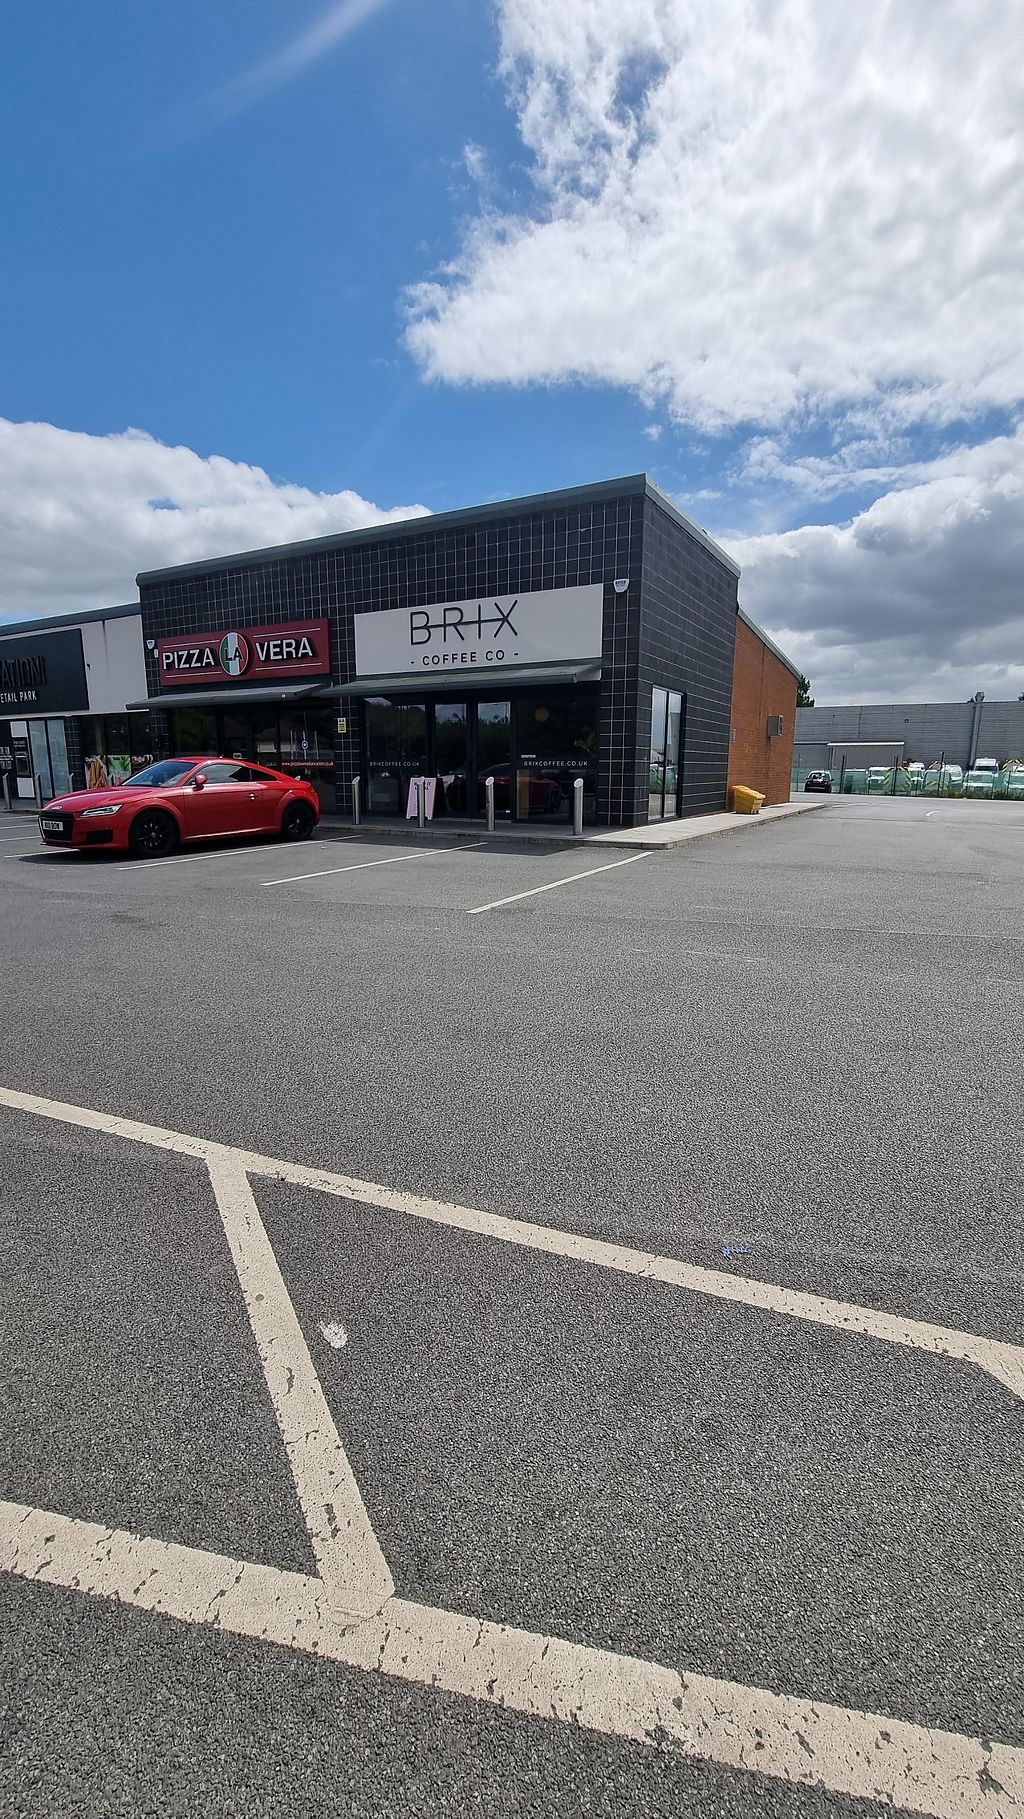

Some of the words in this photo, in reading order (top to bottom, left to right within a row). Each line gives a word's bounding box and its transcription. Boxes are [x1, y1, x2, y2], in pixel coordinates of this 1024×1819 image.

[410, 600, 518, 646] BRIX
[162, 647, 215, 670] PIZZA
[224, 645, 244, 663] LA
[255, 637, 313, 661] VERA
[422, 651, 477, 666] COFFEE
[485, 649, 505, 661] CO
[19, 690, 37, 702] PARK
